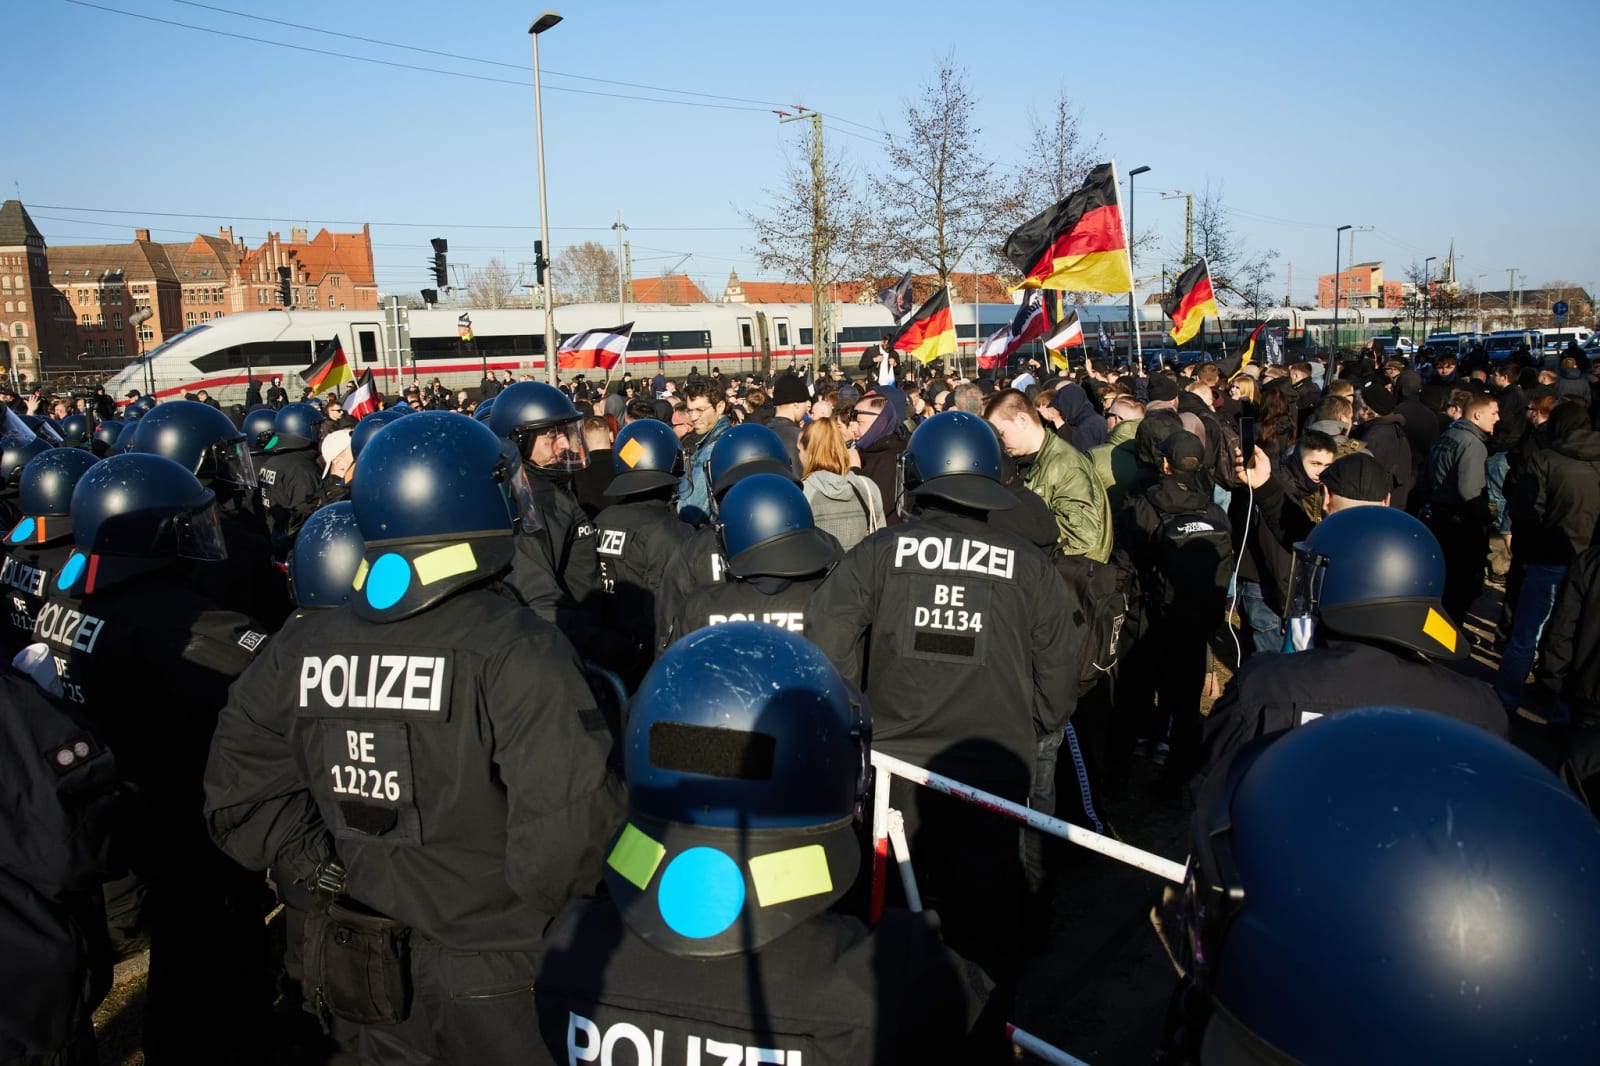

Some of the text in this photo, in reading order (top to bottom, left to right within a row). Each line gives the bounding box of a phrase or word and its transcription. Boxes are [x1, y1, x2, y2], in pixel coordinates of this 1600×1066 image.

[894, 536, 1015, 579] POLIZEI
[934, 584, 965, 607] BE
[34, 601, 105, 654] POLIZEI
[914, 606, 983, 633] D1134
[54, 655, 71, 679] BE
[299, 654, 446, 711] POLIZEI
[346, 730, 376, 764] BE
